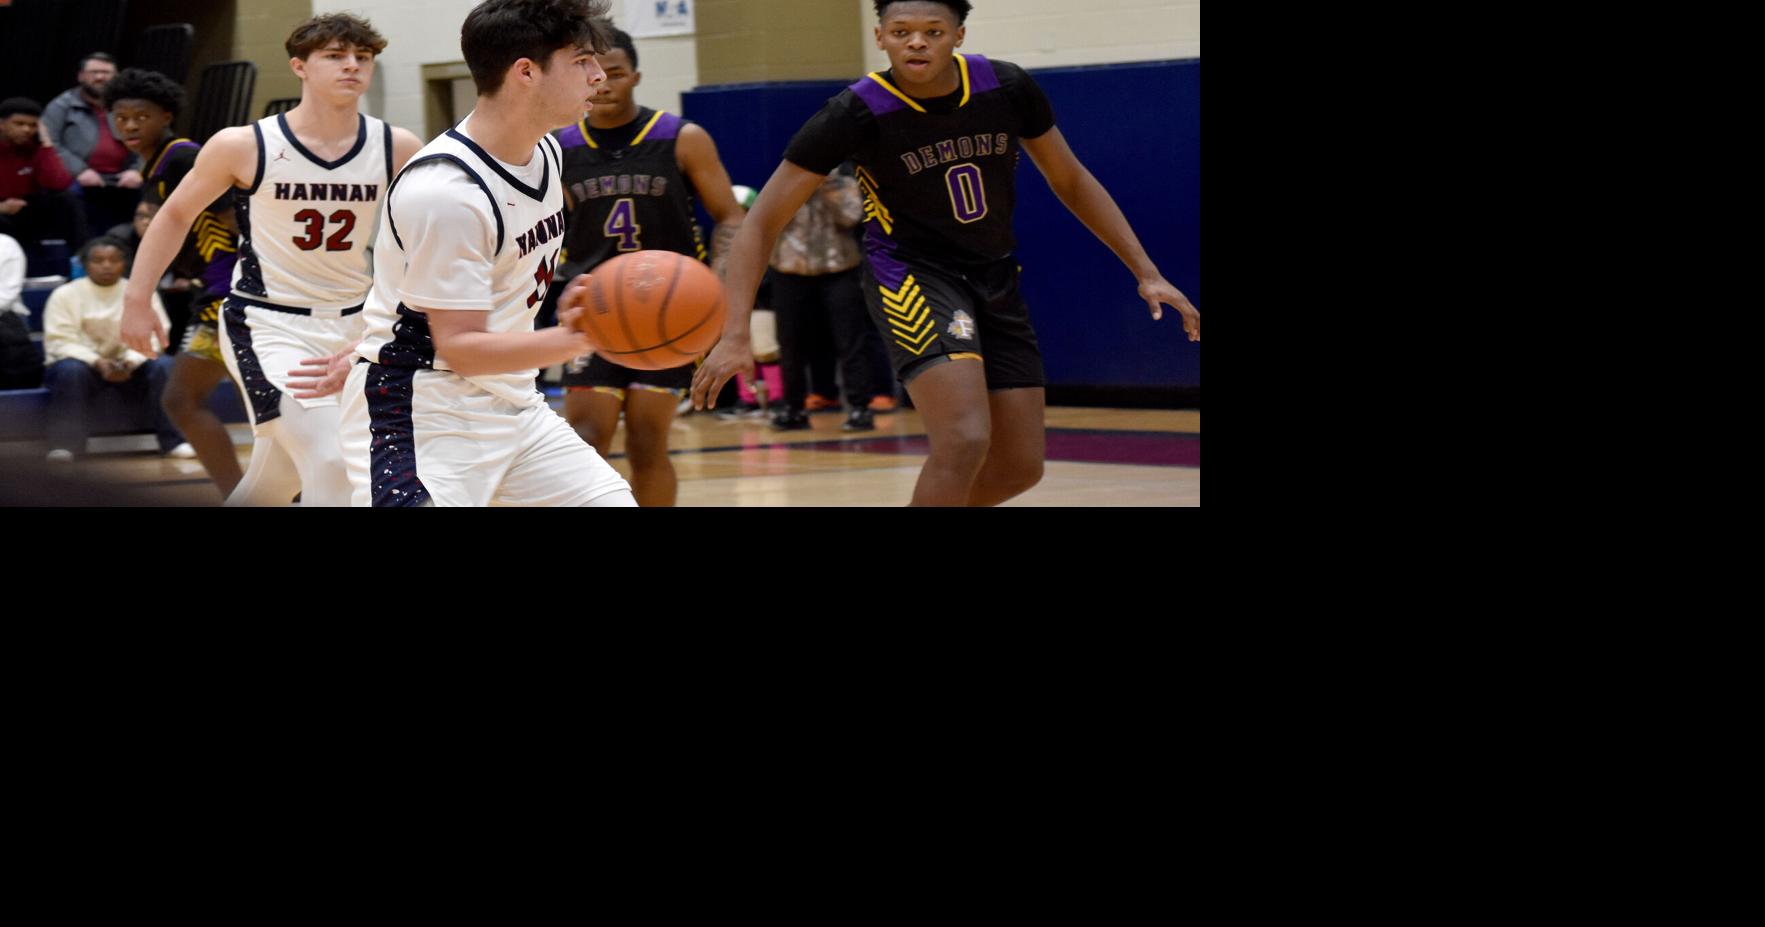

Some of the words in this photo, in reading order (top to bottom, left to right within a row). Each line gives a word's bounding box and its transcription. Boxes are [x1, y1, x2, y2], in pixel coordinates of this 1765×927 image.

[901, 133, 1009, 175] DEMONS
[274, 182, 379, 202] HANNAN
[945, 162, 988, 224] 0
[292, 208, 357, 252] 32
[603, 197, 641, 251] 4
